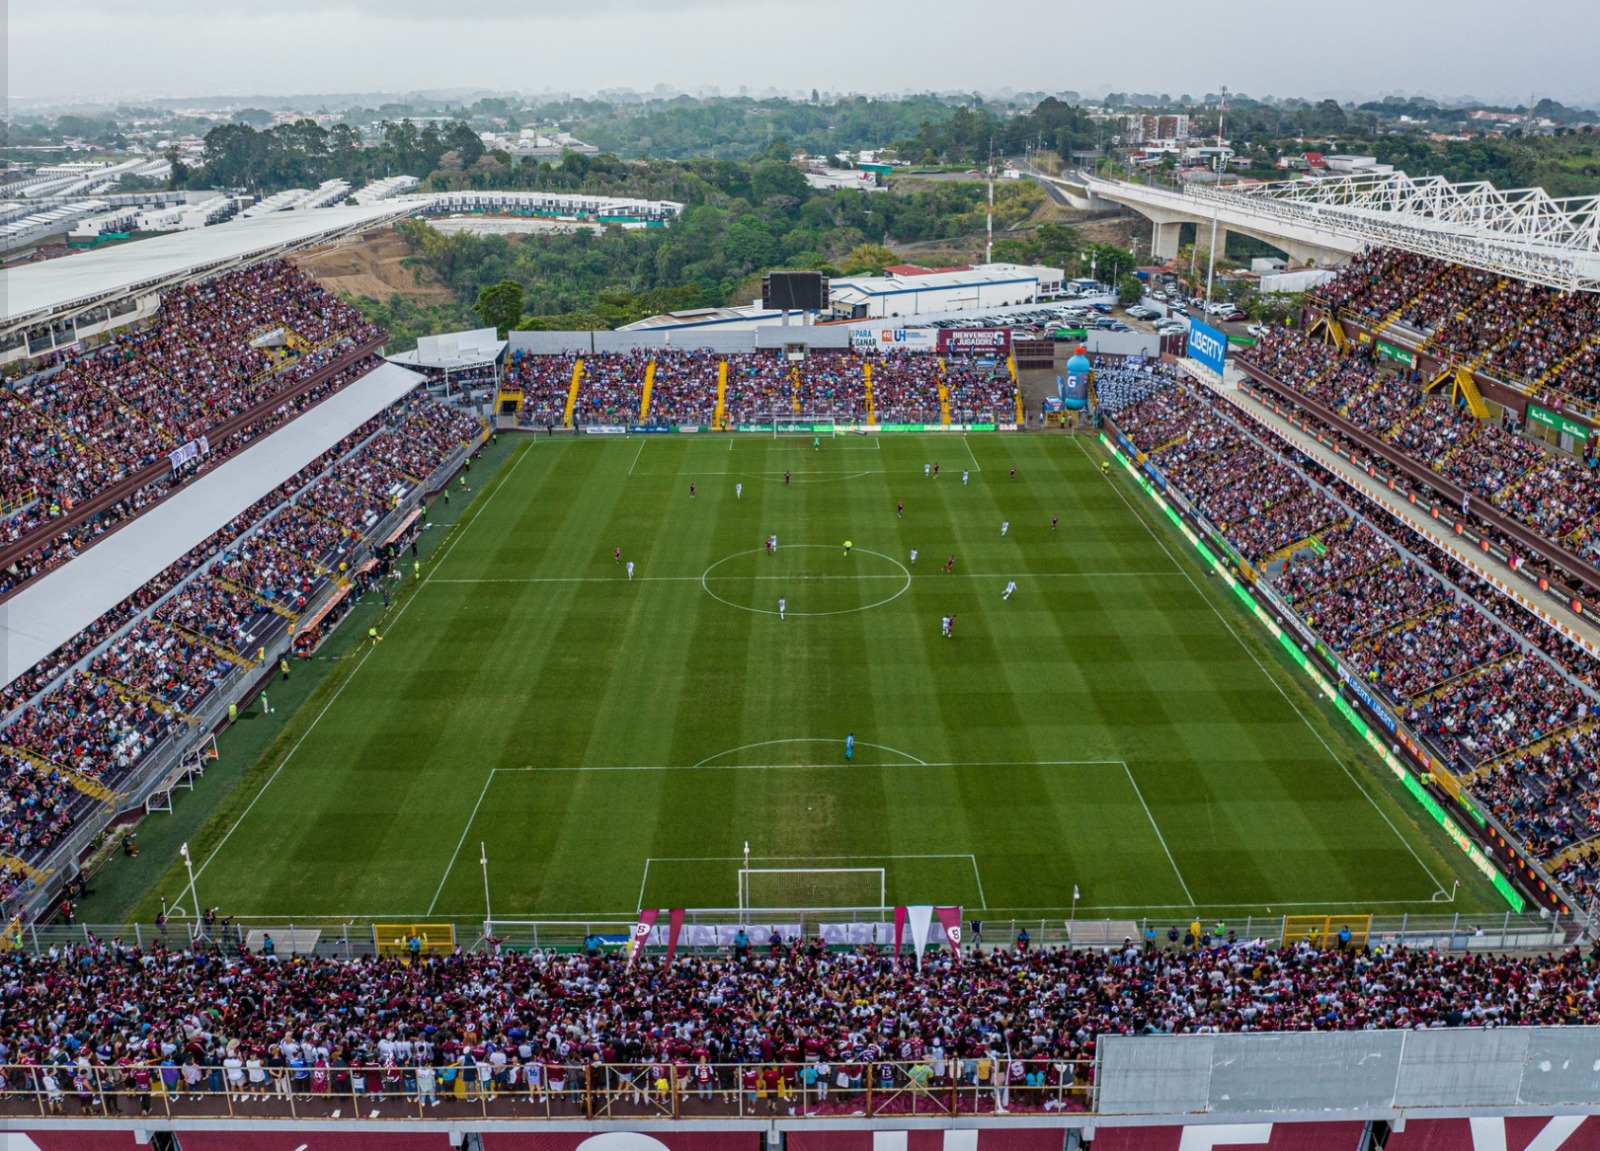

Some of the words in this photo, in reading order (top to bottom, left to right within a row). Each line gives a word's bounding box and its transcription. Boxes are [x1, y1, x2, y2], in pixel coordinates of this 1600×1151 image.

[855, 329, 872, 337] PARA
[855, 338, 877, 347] GANAR
[1190, 328, 1224, 362] LIBERTY
[1067, 375, 1077, 388] G
[1350, 678, 1372, 705] LIBERTY
[1372, 702, 1395, 730] LIBERTY
